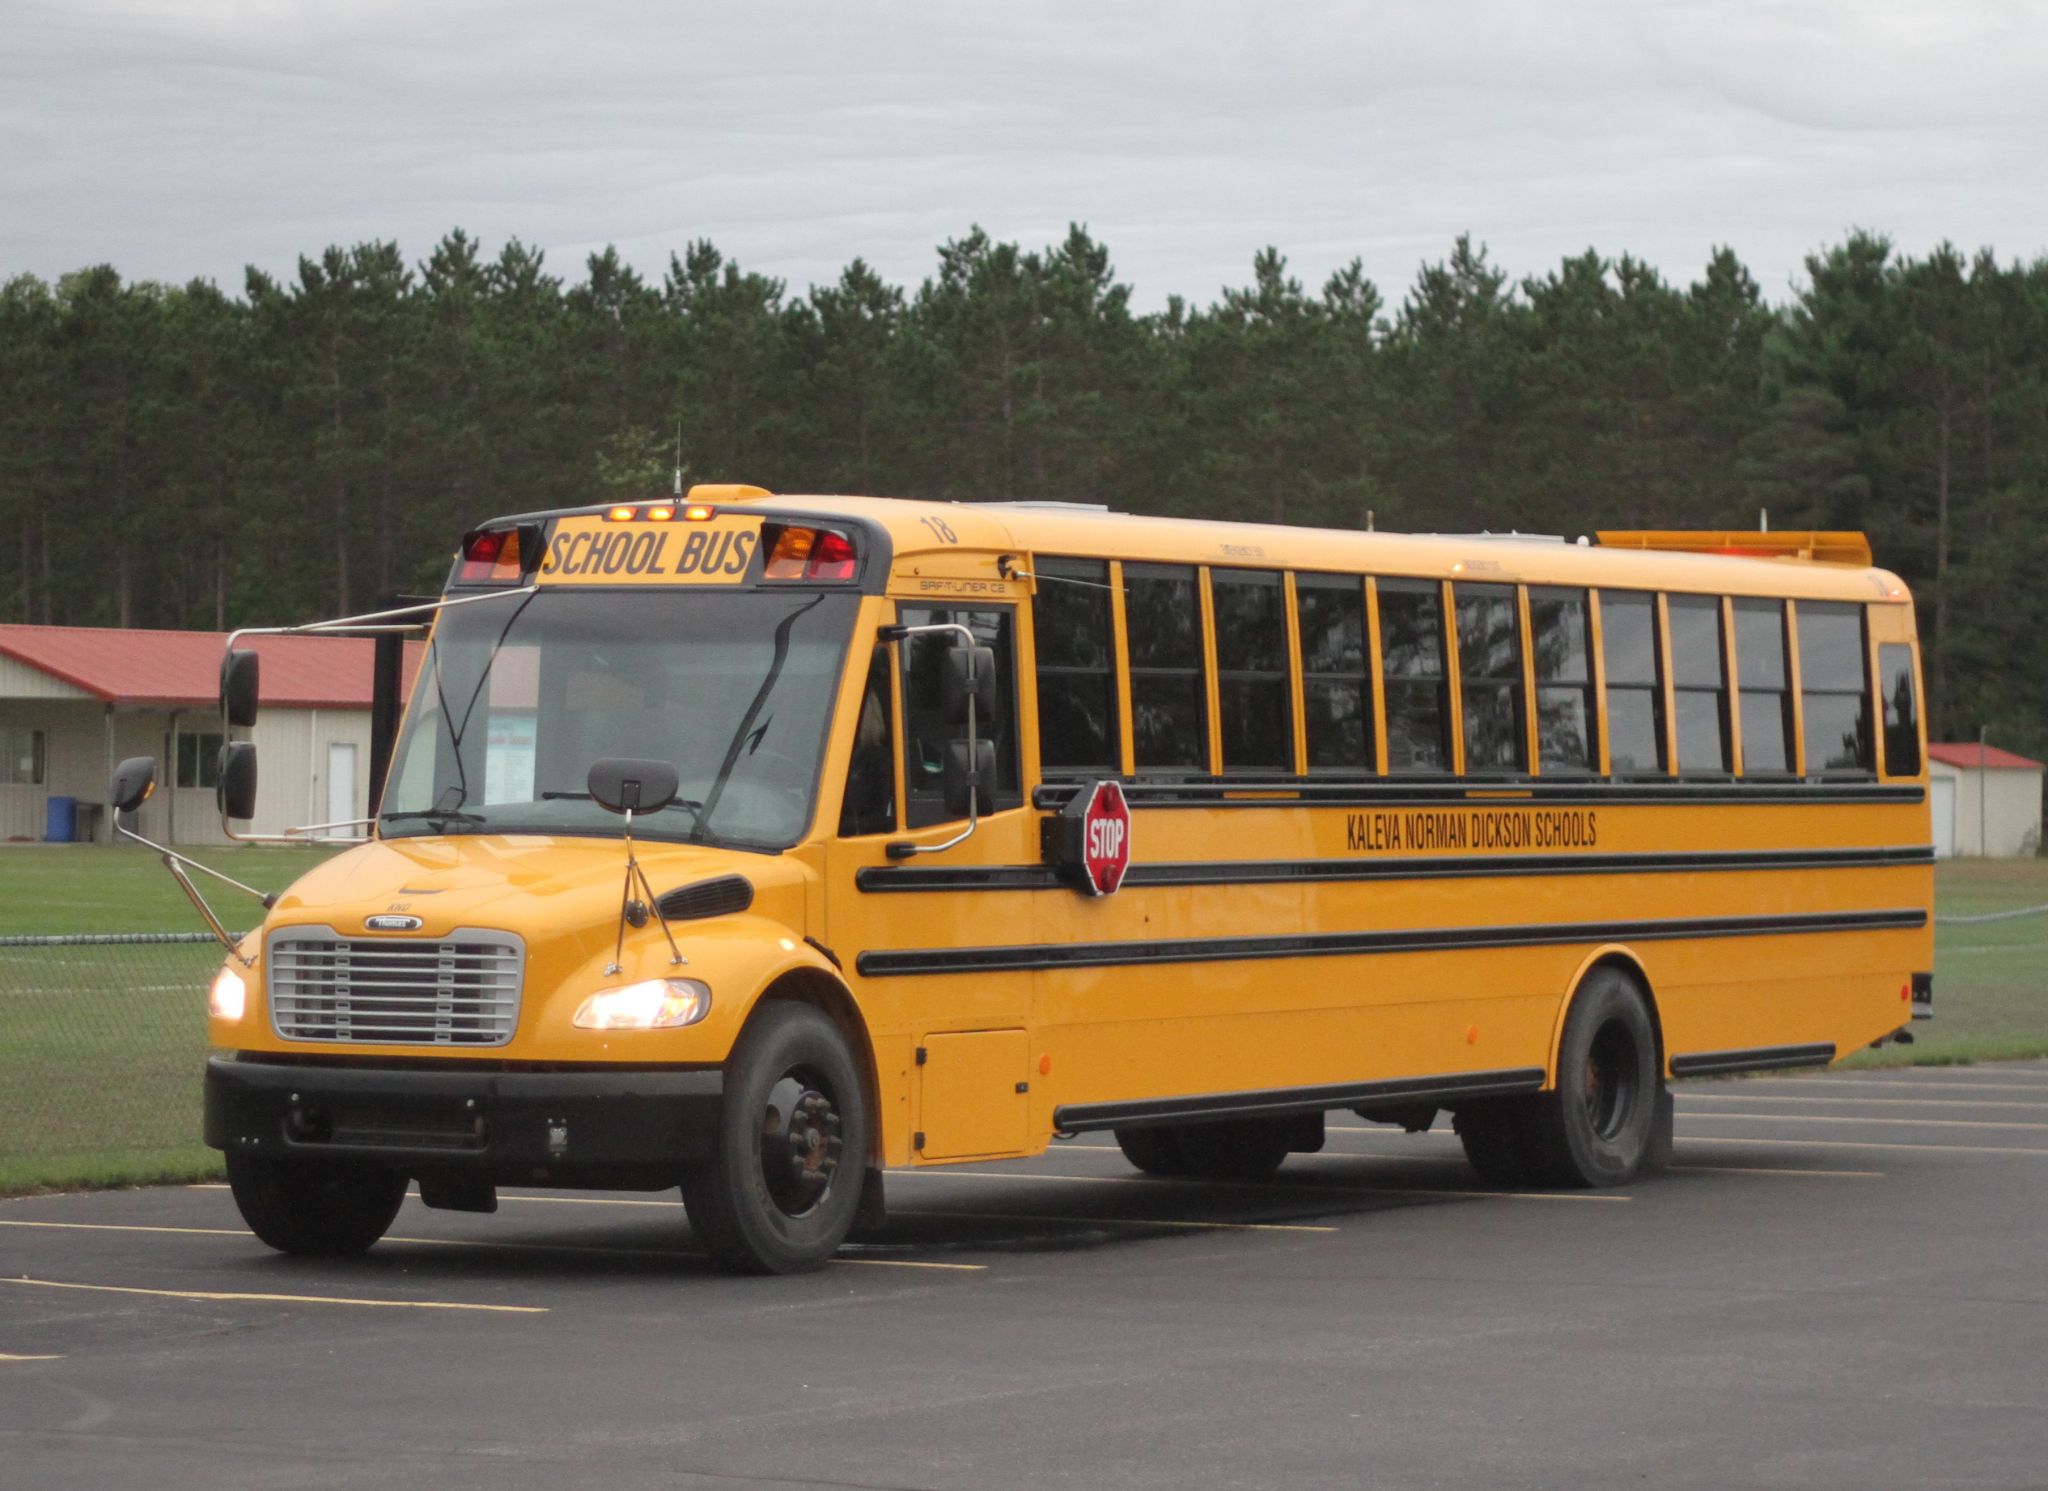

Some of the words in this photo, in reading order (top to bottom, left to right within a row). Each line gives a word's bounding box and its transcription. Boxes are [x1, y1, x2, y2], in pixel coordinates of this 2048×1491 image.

[920, 517, 958, 544] 18
[542, 531, 669, 575] SCHOOL
[675, 530, 756, 575] BUS
[1090, 818, 1125, 859] STOP
[1347, 814, 1401, 850] KALEVA
[1405, 813, 1467, 849] NORMAN
[1471, 812, 1531, 848] DICKSON
[1535, 811, 1597, 847] SCHOOLS
